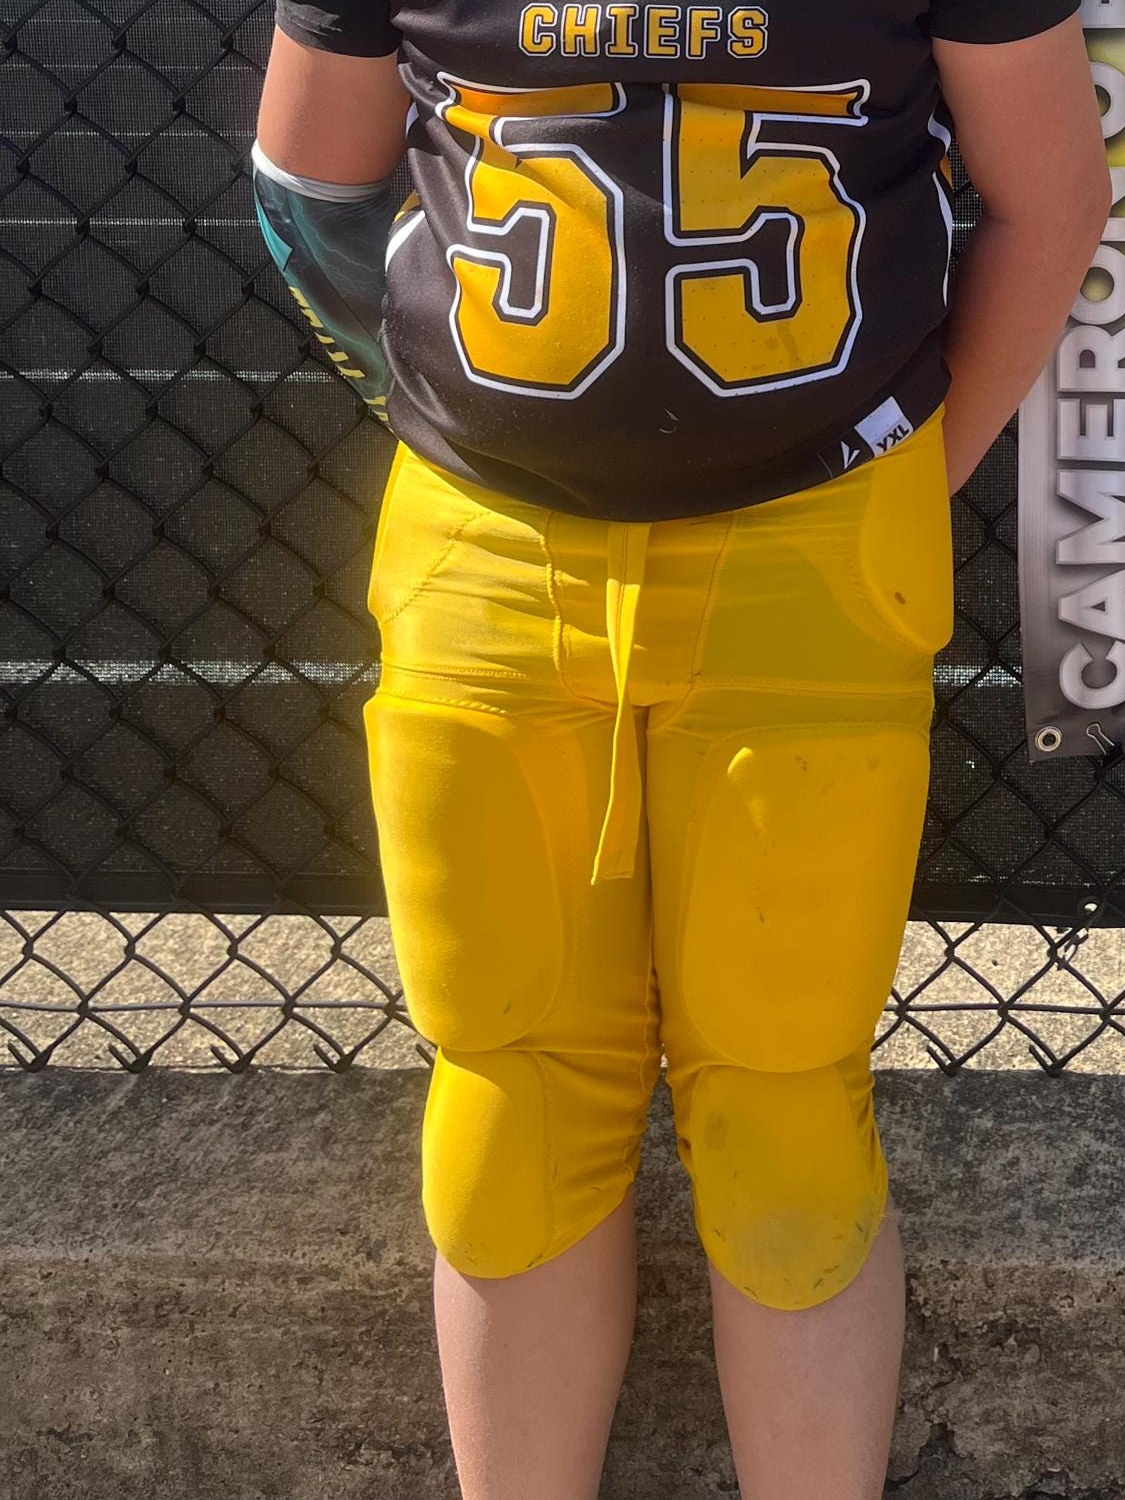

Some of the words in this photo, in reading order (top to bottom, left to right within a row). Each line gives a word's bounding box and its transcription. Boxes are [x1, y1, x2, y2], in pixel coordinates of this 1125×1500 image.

[518, 2, 769, 60] CHIEFS
[435, 71, 870, 400] 55
[876, 424, 910, 452] YXL
